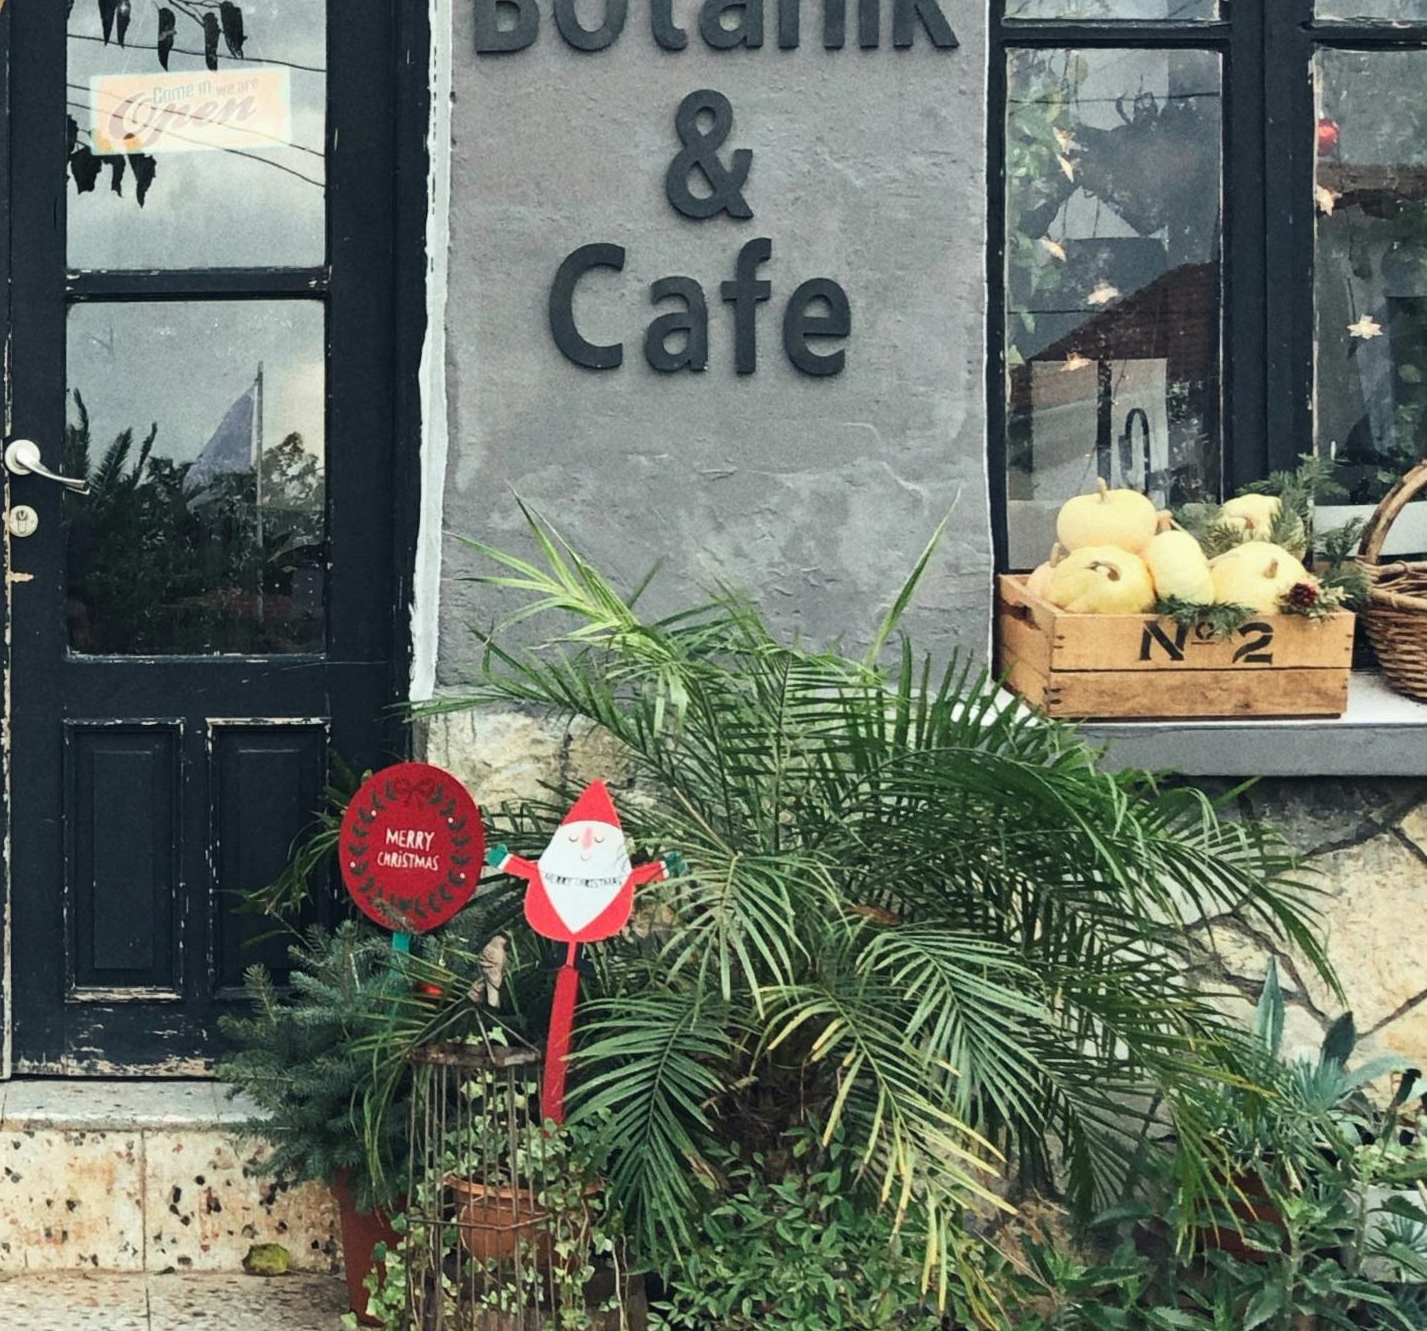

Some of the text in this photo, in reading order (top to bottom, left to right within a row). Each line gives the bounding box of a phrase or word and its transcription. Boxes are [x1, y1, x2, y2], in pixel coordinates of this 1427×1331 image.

[152, 77, 260, 105] Come in we are
[108, 91, 259, 149] Open
[665, 89, 754, 220] &
[549, 237, 851, 377] Cafe
[1232, 621, 1274, 664] 2
[385, 827, 436, 852] MERRY
